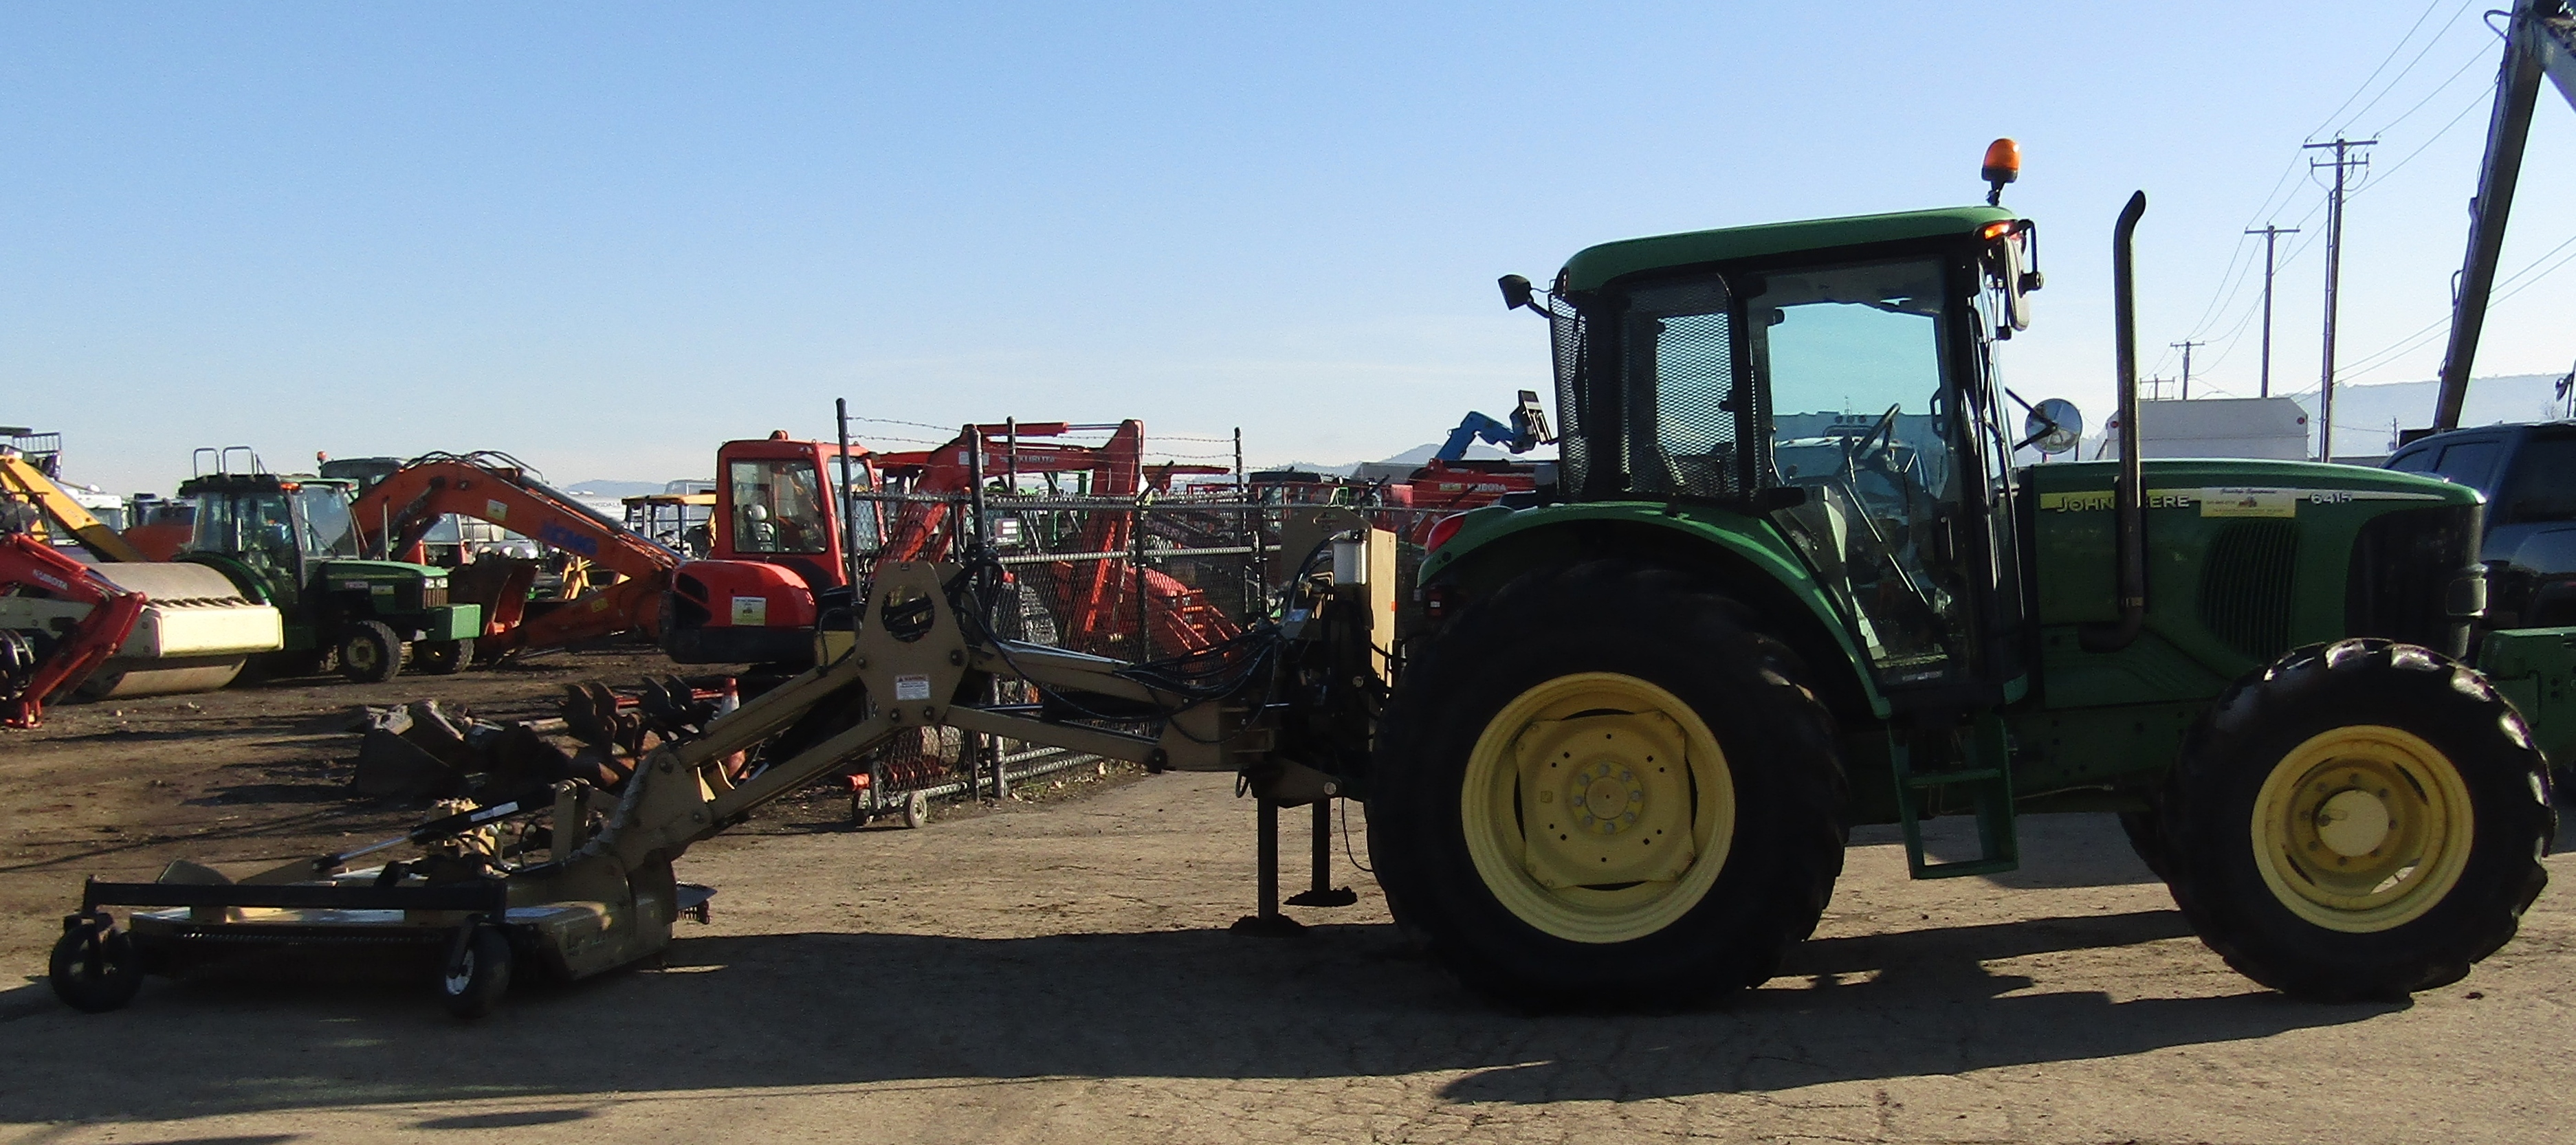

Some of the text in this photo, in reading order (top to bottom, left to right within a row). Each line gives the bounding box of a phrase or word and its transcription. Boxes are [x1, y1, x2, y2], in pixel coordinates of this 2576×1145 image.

[2056, 495, 2190, 513] JOHN ERE
[2311, 492, 2352, 504] 6415
